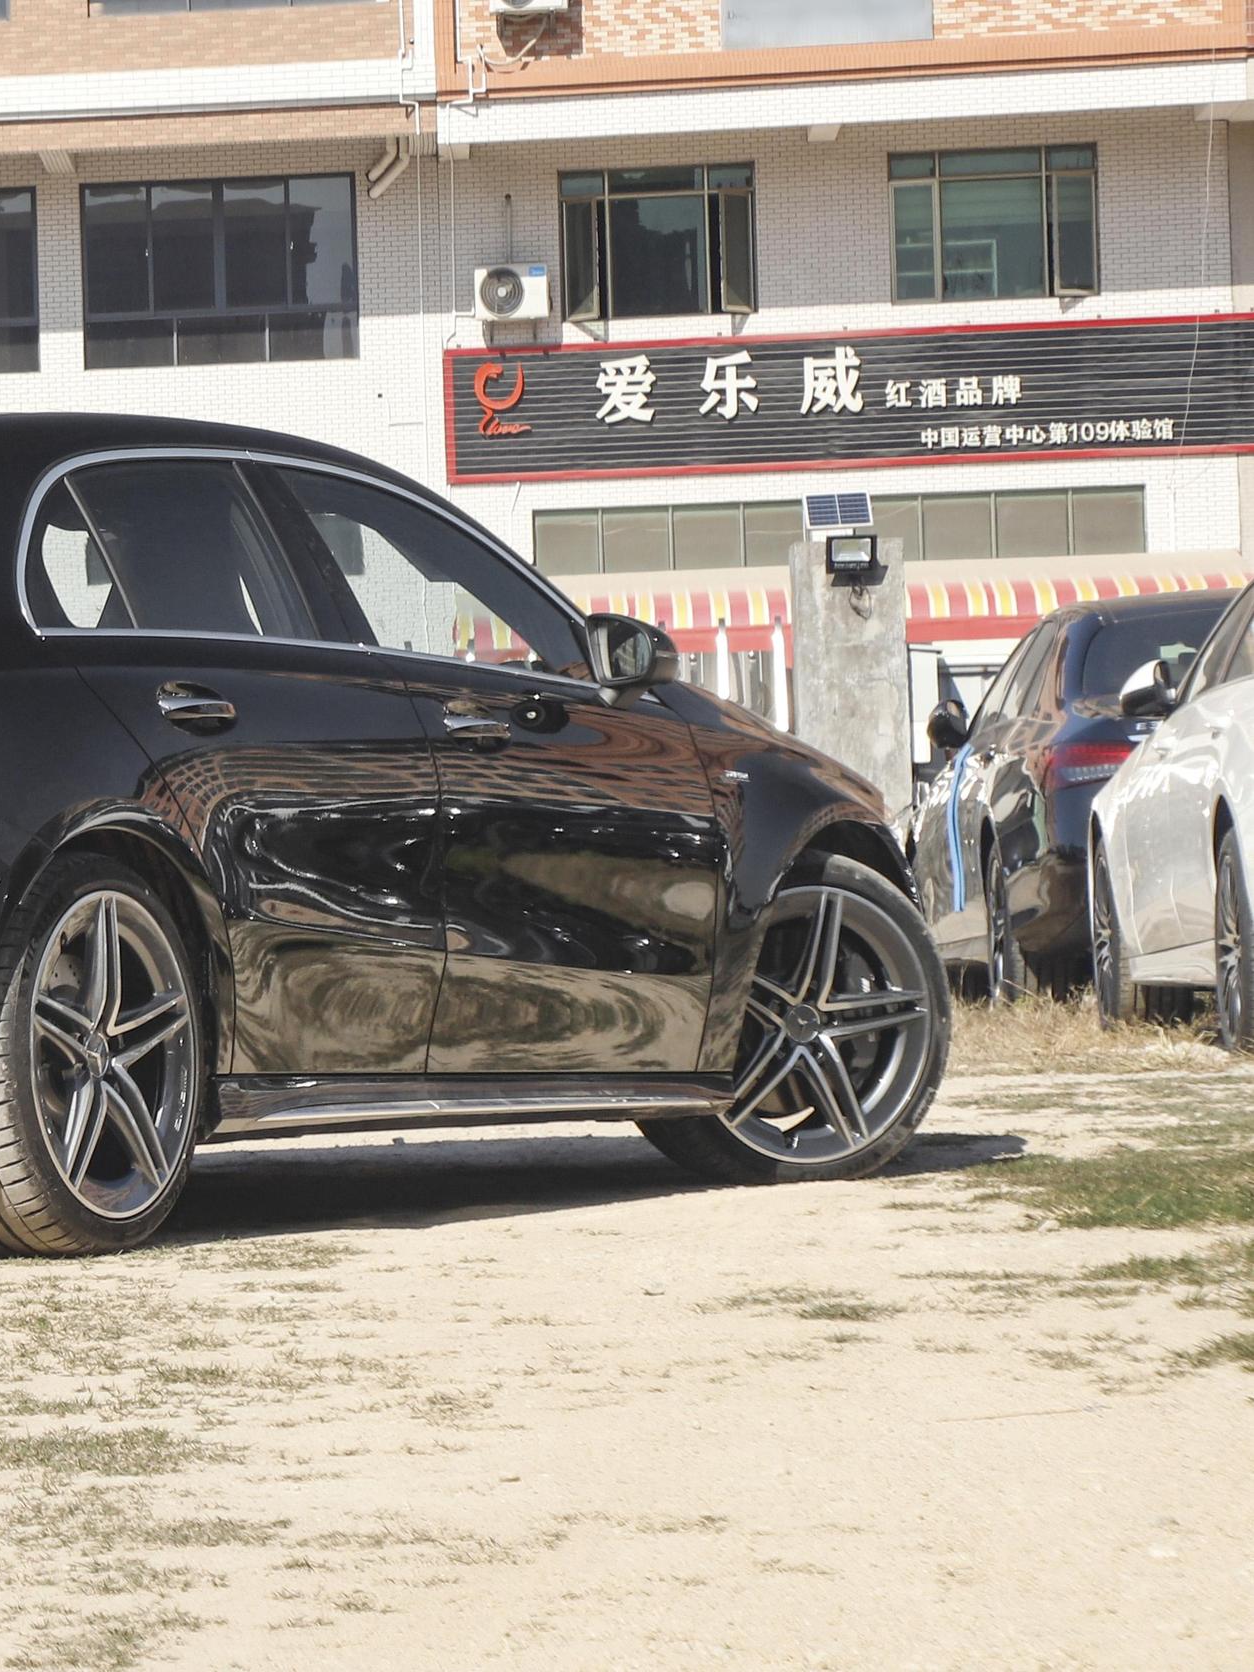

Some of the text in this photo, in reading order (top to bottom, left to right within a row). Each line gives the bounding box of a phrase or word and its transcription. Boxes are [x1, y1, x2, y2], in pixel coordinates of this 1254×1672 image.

[596, 346, 863, 423] 爱乐威
[885, 375, 1022, 408] 红酒品牌
[920, 418, 1174, 449] 中国运营中心第109体验馆
